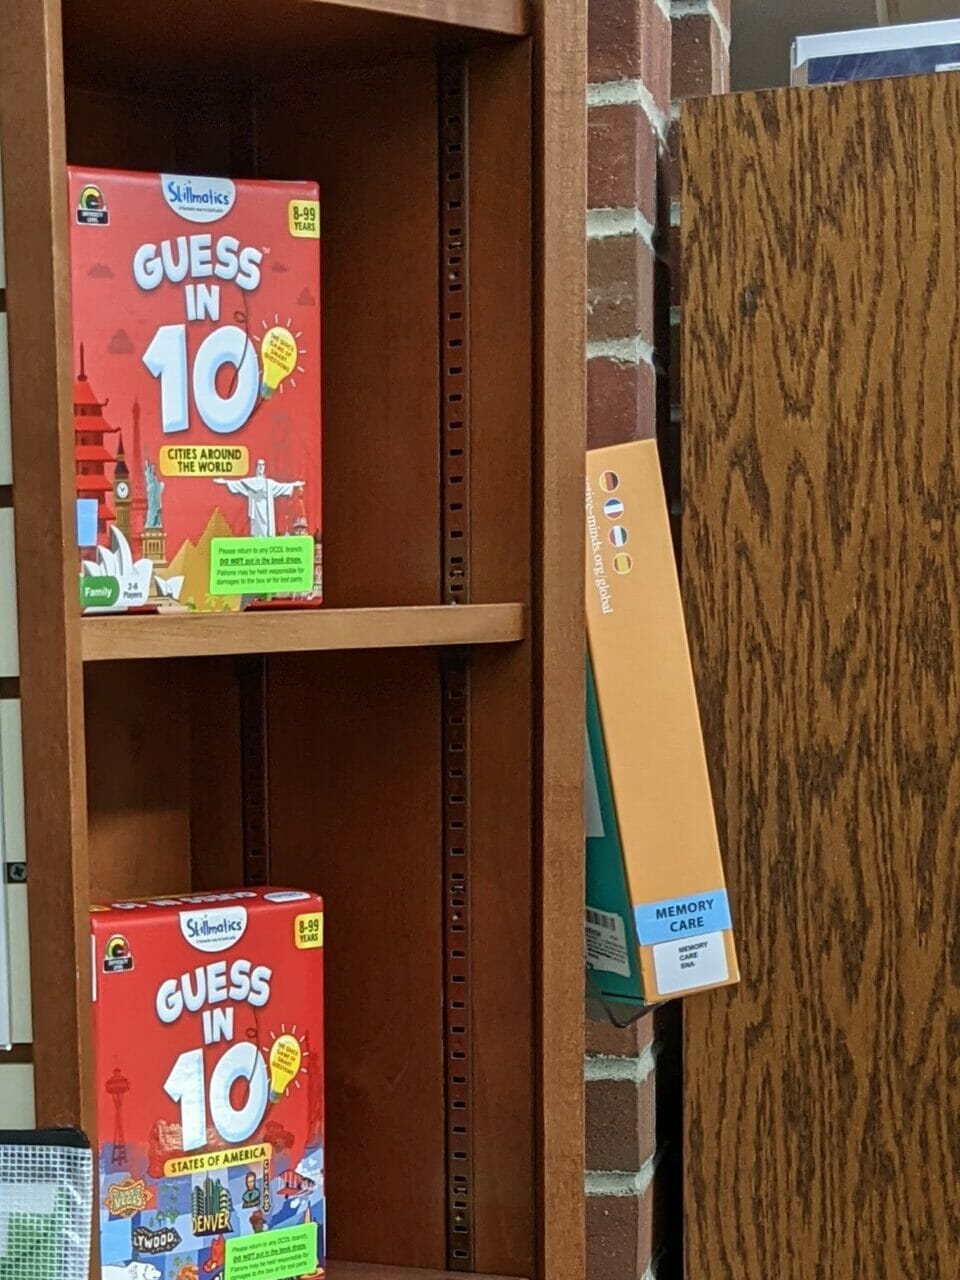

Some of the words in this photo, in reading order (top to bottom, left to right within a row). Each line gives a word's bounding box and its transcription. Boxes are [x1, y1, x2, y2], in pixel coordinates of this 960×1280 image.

[293, 205, 316, 221] 8-99
[294, 221, 316, 232] YEARS
[133, 233, 263, 290] GUESS
[184, 283, 221, 322] IN
[142, 323, 261, 434] 10
[167, 448, 198, 460] CITIES
[200, 448, 242, 460] AROUND
[177, 461, 196, 473] THE
[198, 461, 233, 473] WORLD
[84, 586, 113, 599] Family
[655, 897, 715, 920] MEMORY
[298, 918, 320, 934] 8-99
[669, 915, 705, 933] CARE
[299, 932, 319, 943] YEARS
[678, 941, 709, 953] MEMORY
[679, 951, 699, 961] CARE
[155, 959, 273, 1024] GUESS
[201, 1006, 234, 1045] IN
[163, 1041, 269, 1151] 10
[170, 1156, 205, 1174] STATES
[207, 1153, 220, 1167] OF
[222, 1147, 266, 1165] AMERICA
[192, 1211, 232, 1233] DENVER
